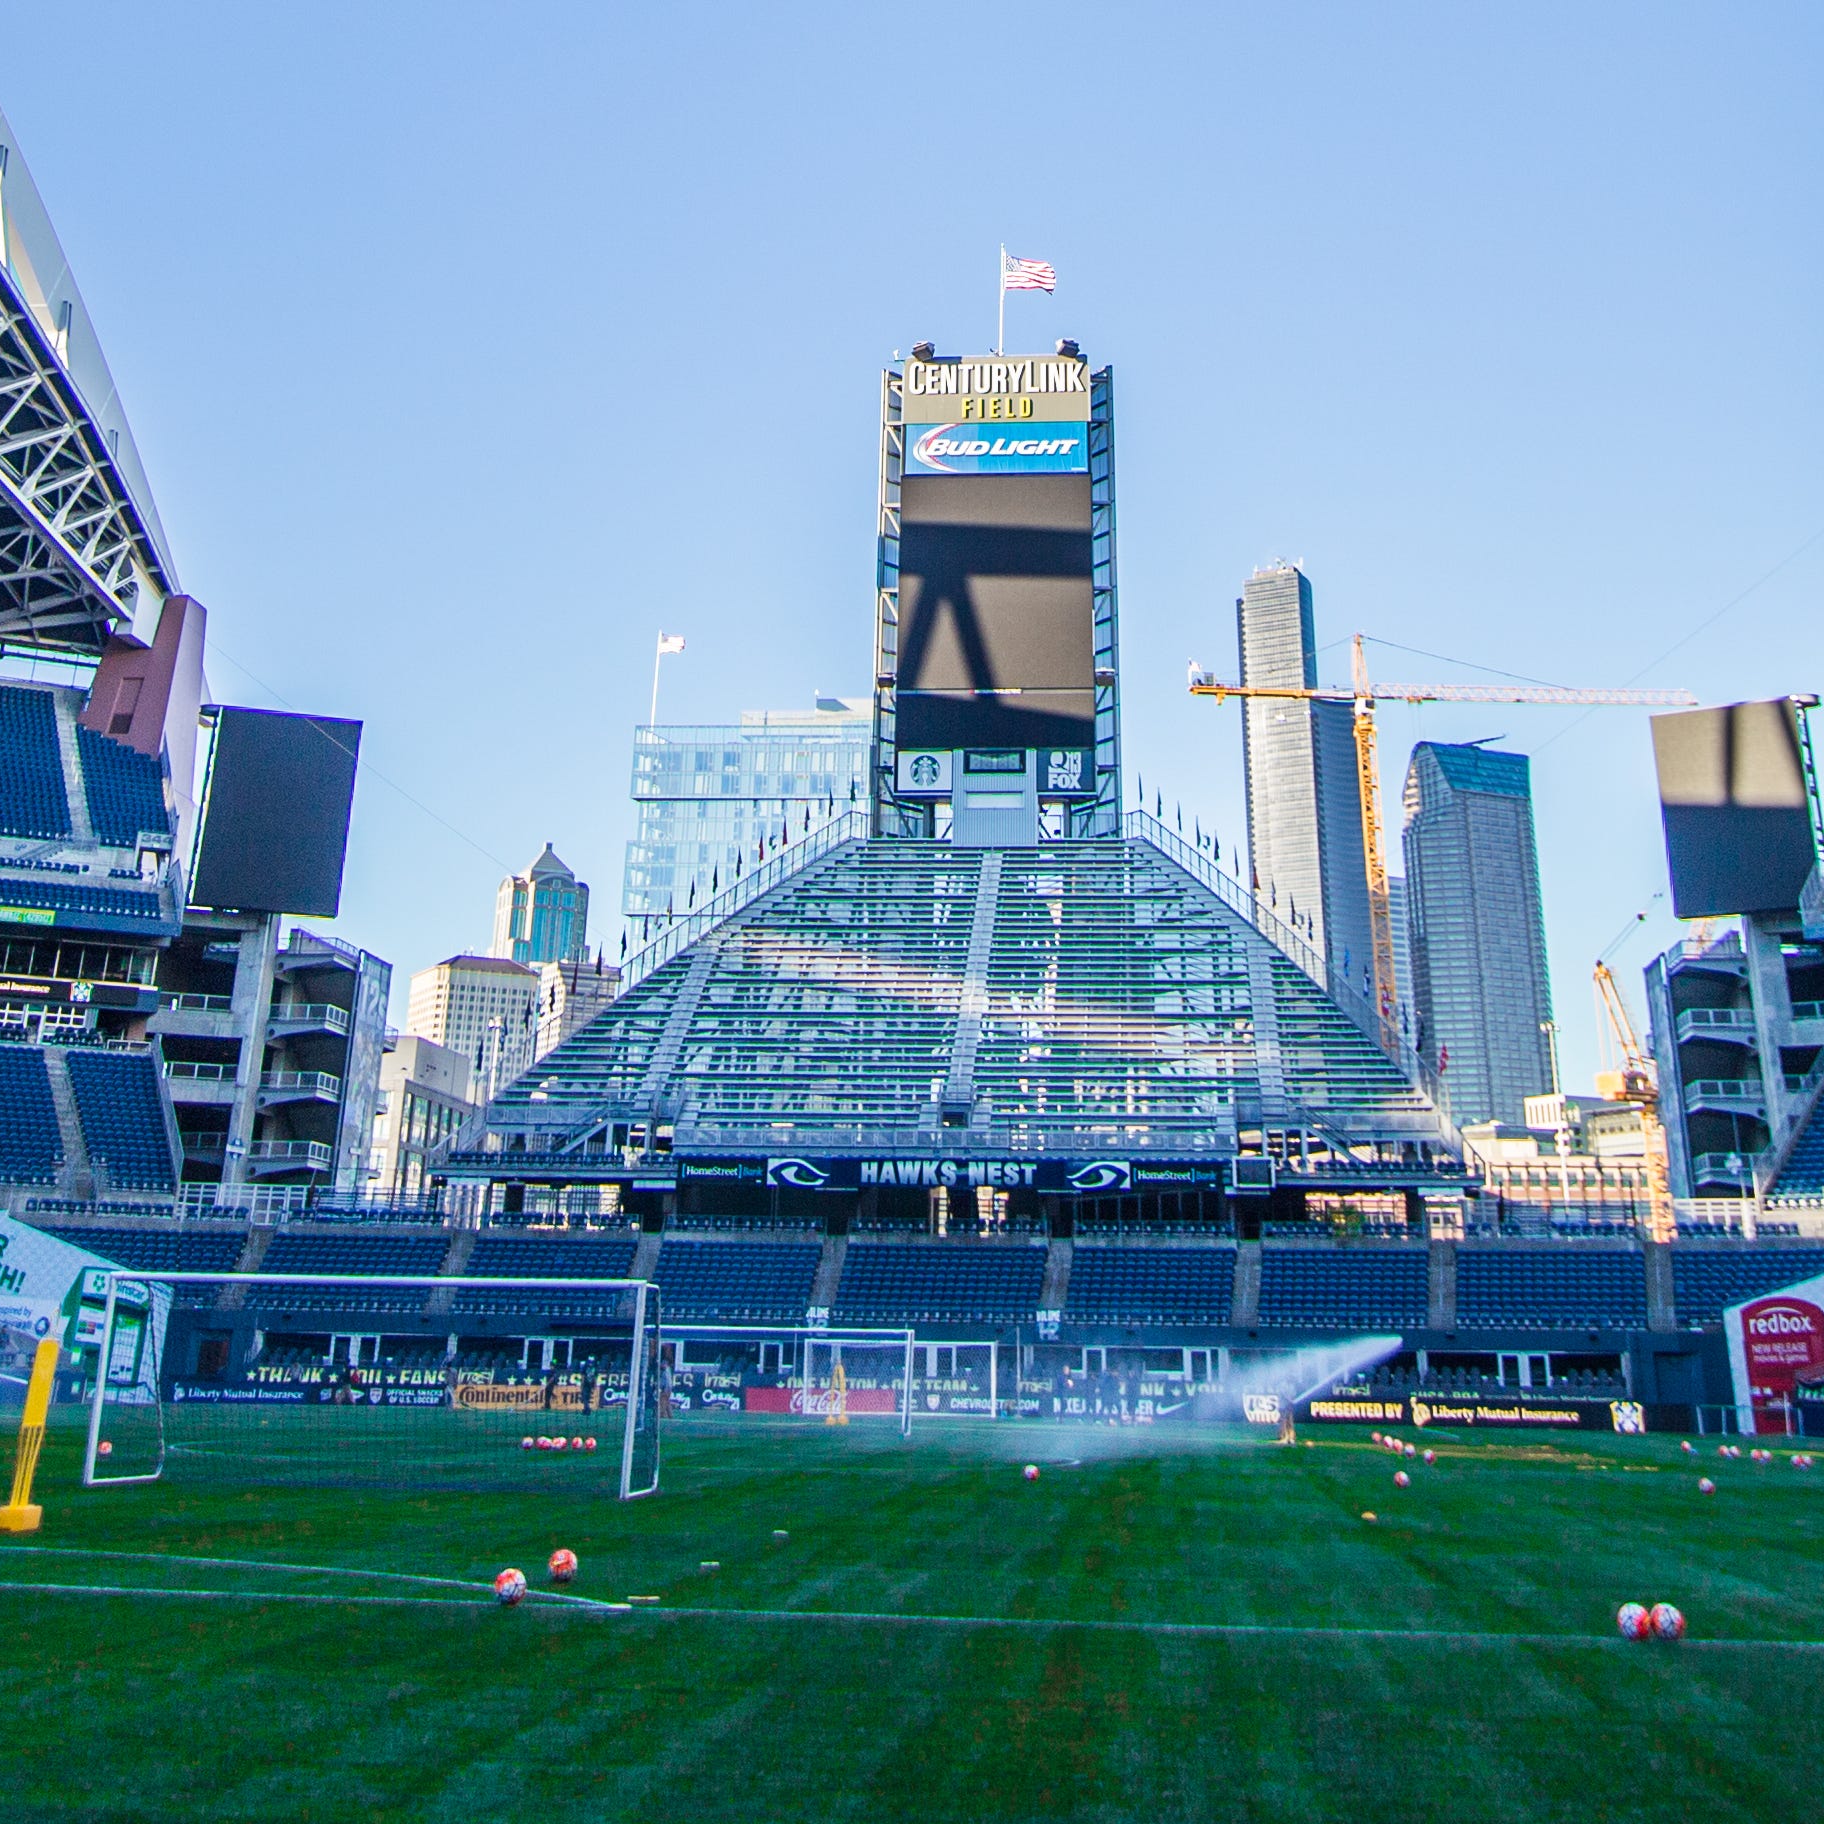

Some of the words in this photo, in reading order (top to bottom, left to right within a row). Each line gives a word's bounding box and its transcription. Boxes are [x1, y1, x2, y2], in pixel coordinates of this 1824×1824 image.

[961, 397, 1033, 419] FIELD
[927, 438, 990, 457] BUD
[990, 437, 1078, 455] LIGHT
[1048, 773, 1081, 789] FOX
[11, 982, 50, 993] Insurance
[861, 1161, 957, 1186] HAWKS
[969, 1163, 1037, 1186] NEST
[1749, 1315, 1813, 1334] redbox
[1772, 1342, 1807, 1353] RELEASE
[188, 1387, 221, 1402] Liberty
[223, 1388, 256, 1400] Mutual
[258, 1389, 304, 1400] Insurance
[386, 1388, 416, 1397] OFFICIAL
[416, 1389, 444, 1397] SNACKS
[388, 1396, 401, 1404] OF
[402, 1396, 413, 1404] U.S.
[414, 1396, 440, 1405] SOCCER
[459, 1385, 547, 1405] Continental
[1311, 1401, 1383, 1419] PRESENTED
[1384, 1402, 1403, 1419] BY
[1432, 1405, 1474, 1424] Liberty
[1477, 1406, 1519, 1420] Mutual
[1521, 1408, 1580, 1422] Insurance
